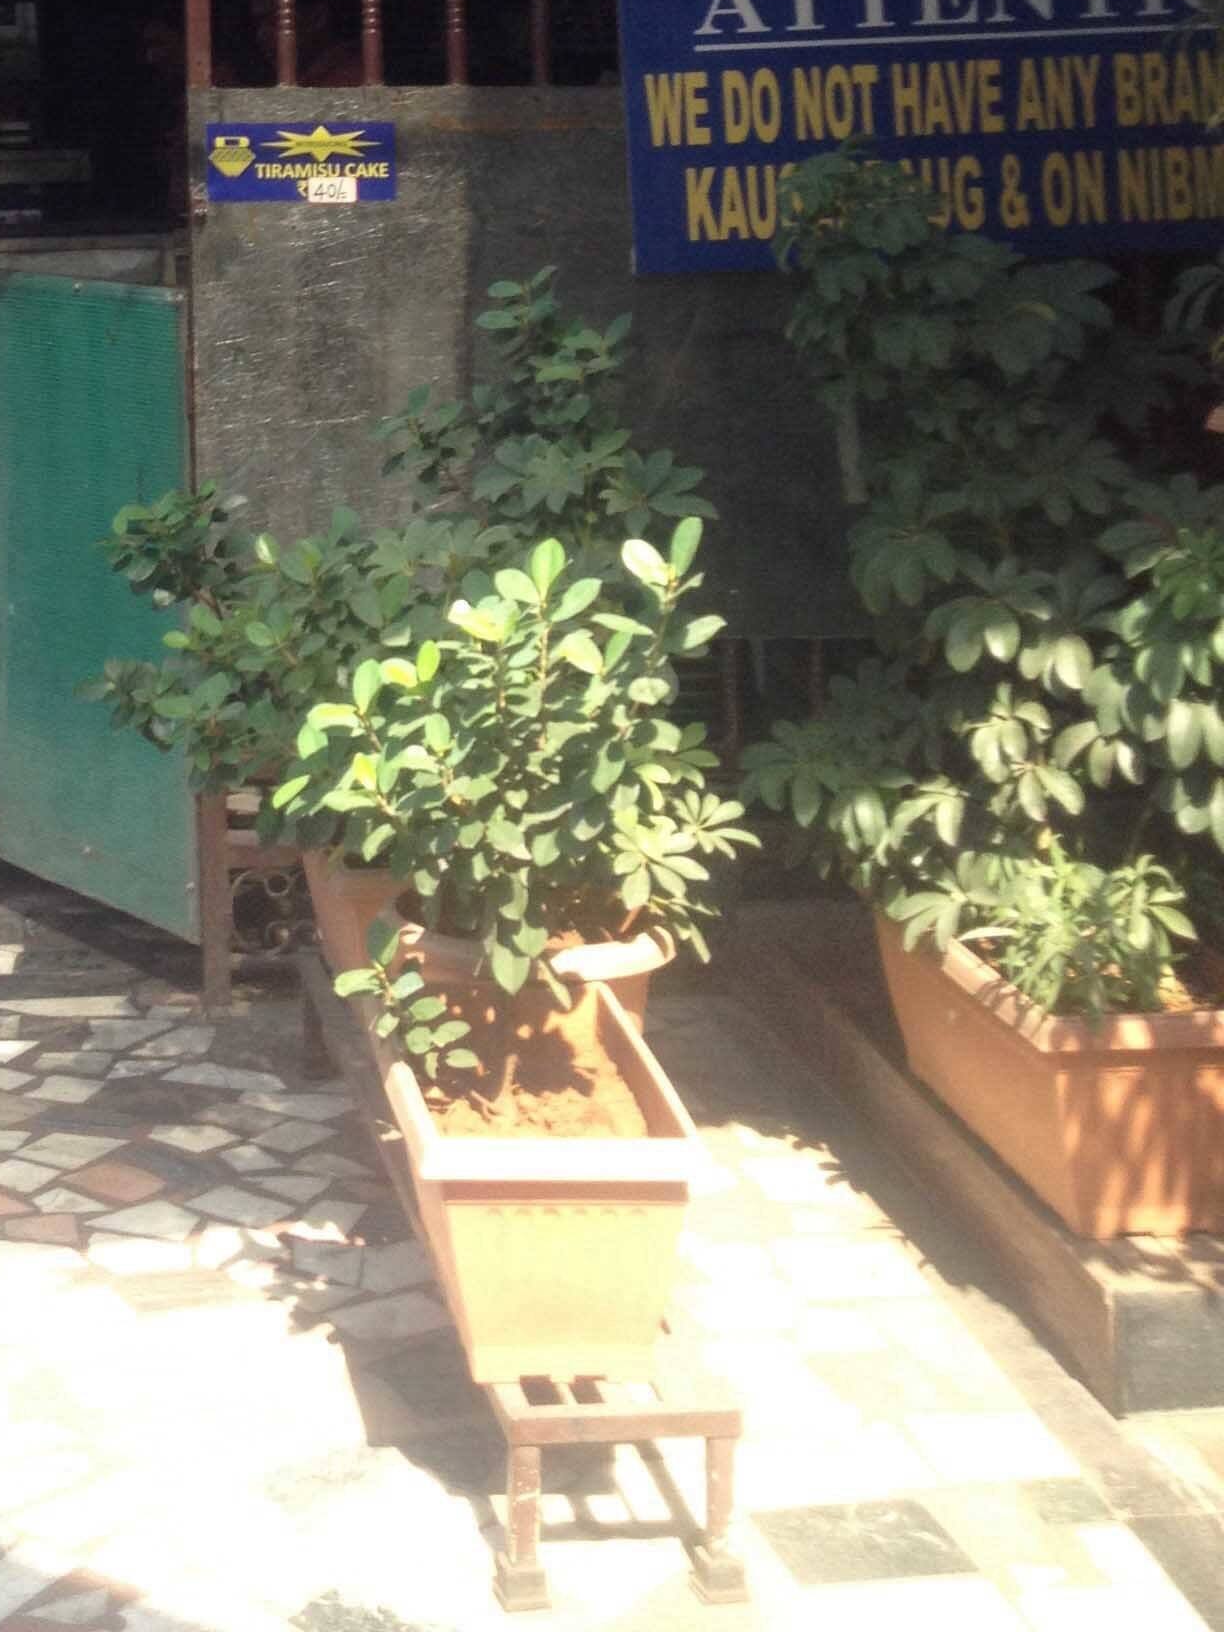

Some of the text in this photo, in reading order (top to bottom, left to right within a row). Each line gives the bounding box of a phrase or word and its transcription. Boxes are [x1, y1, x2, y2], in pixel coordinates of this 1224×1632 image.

[644, 71, 712, 147] WE
[721, 68, 781, 145] DO
[793, 64, 879, 141] NOT
[892, 59, 1005, 137] HAVE
[1016, 55, 1101, 132] ANY
[255, 163, 390, 179] TIRAMISU CAKE
[999, 154, 1030, 229] &
[1042, 150, 1108, 225] ON
